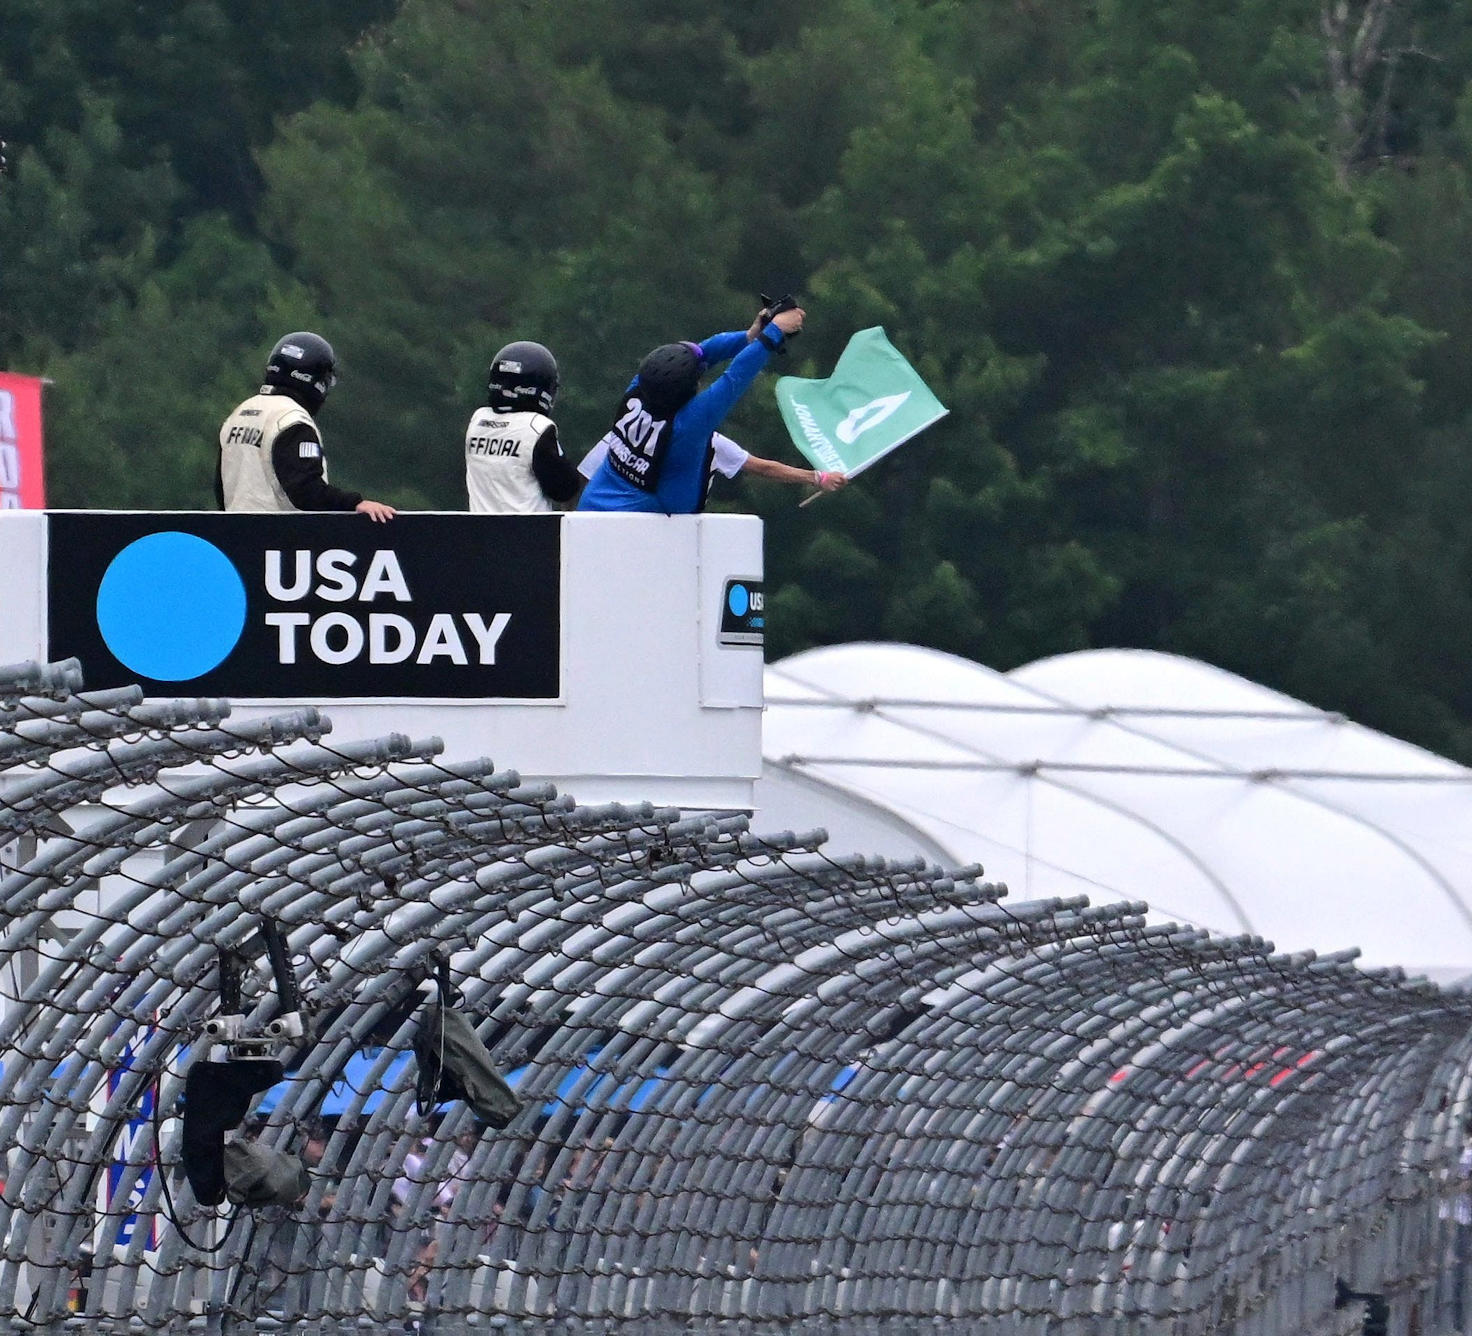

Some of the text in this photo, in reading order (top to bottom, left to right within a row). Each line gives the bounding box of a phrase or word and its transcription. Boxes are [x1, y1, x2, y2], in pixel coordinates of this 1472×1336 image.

[468, 437, 521, 458] FFICIAL
[615, 398, 666, 457] 201
[265, 549, 412, 602] USA
[749, 591, 764, 611] US
[265, 612, 512, 665] TODAY
